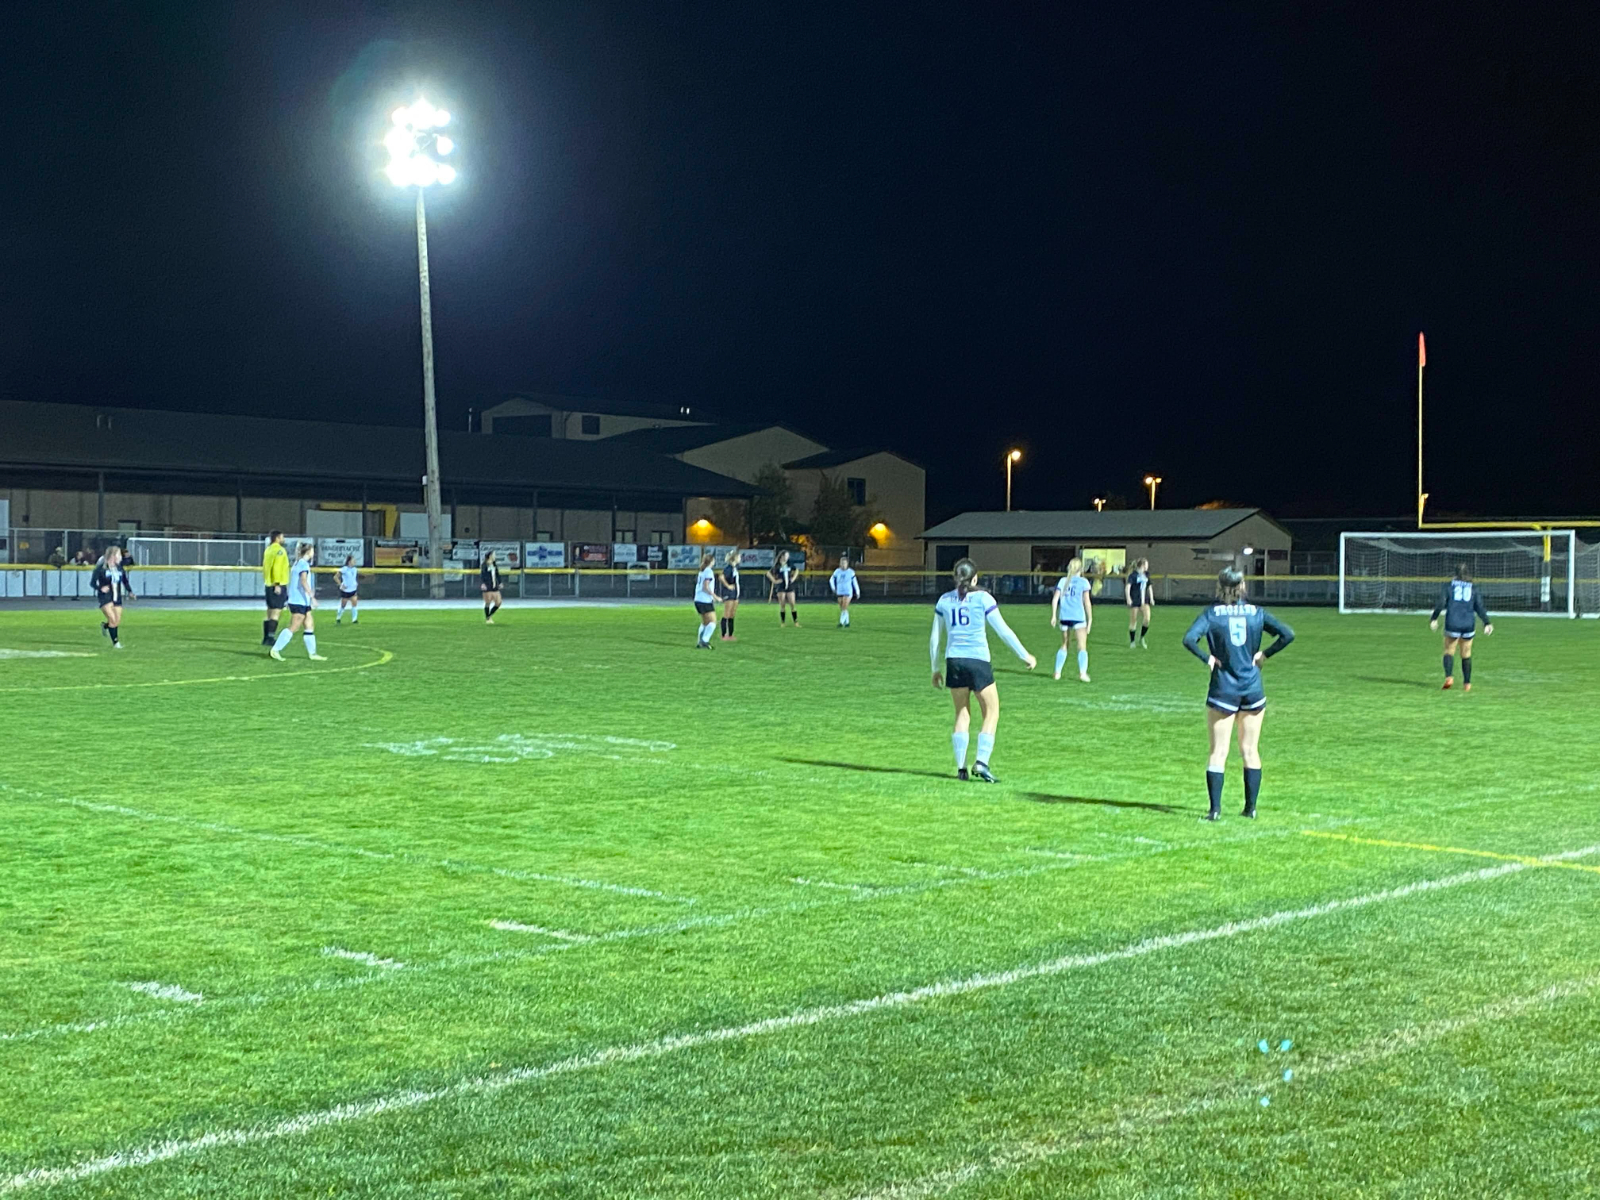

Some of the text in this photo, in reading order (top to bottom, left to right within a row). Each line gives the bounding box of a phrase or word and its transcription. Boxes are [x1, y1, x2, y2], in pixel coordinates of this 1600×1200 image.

[1454, 585, 1472, 602] 20
[951, 606, 970, 627] 16
[1229, 616, 1247, 647] 5
